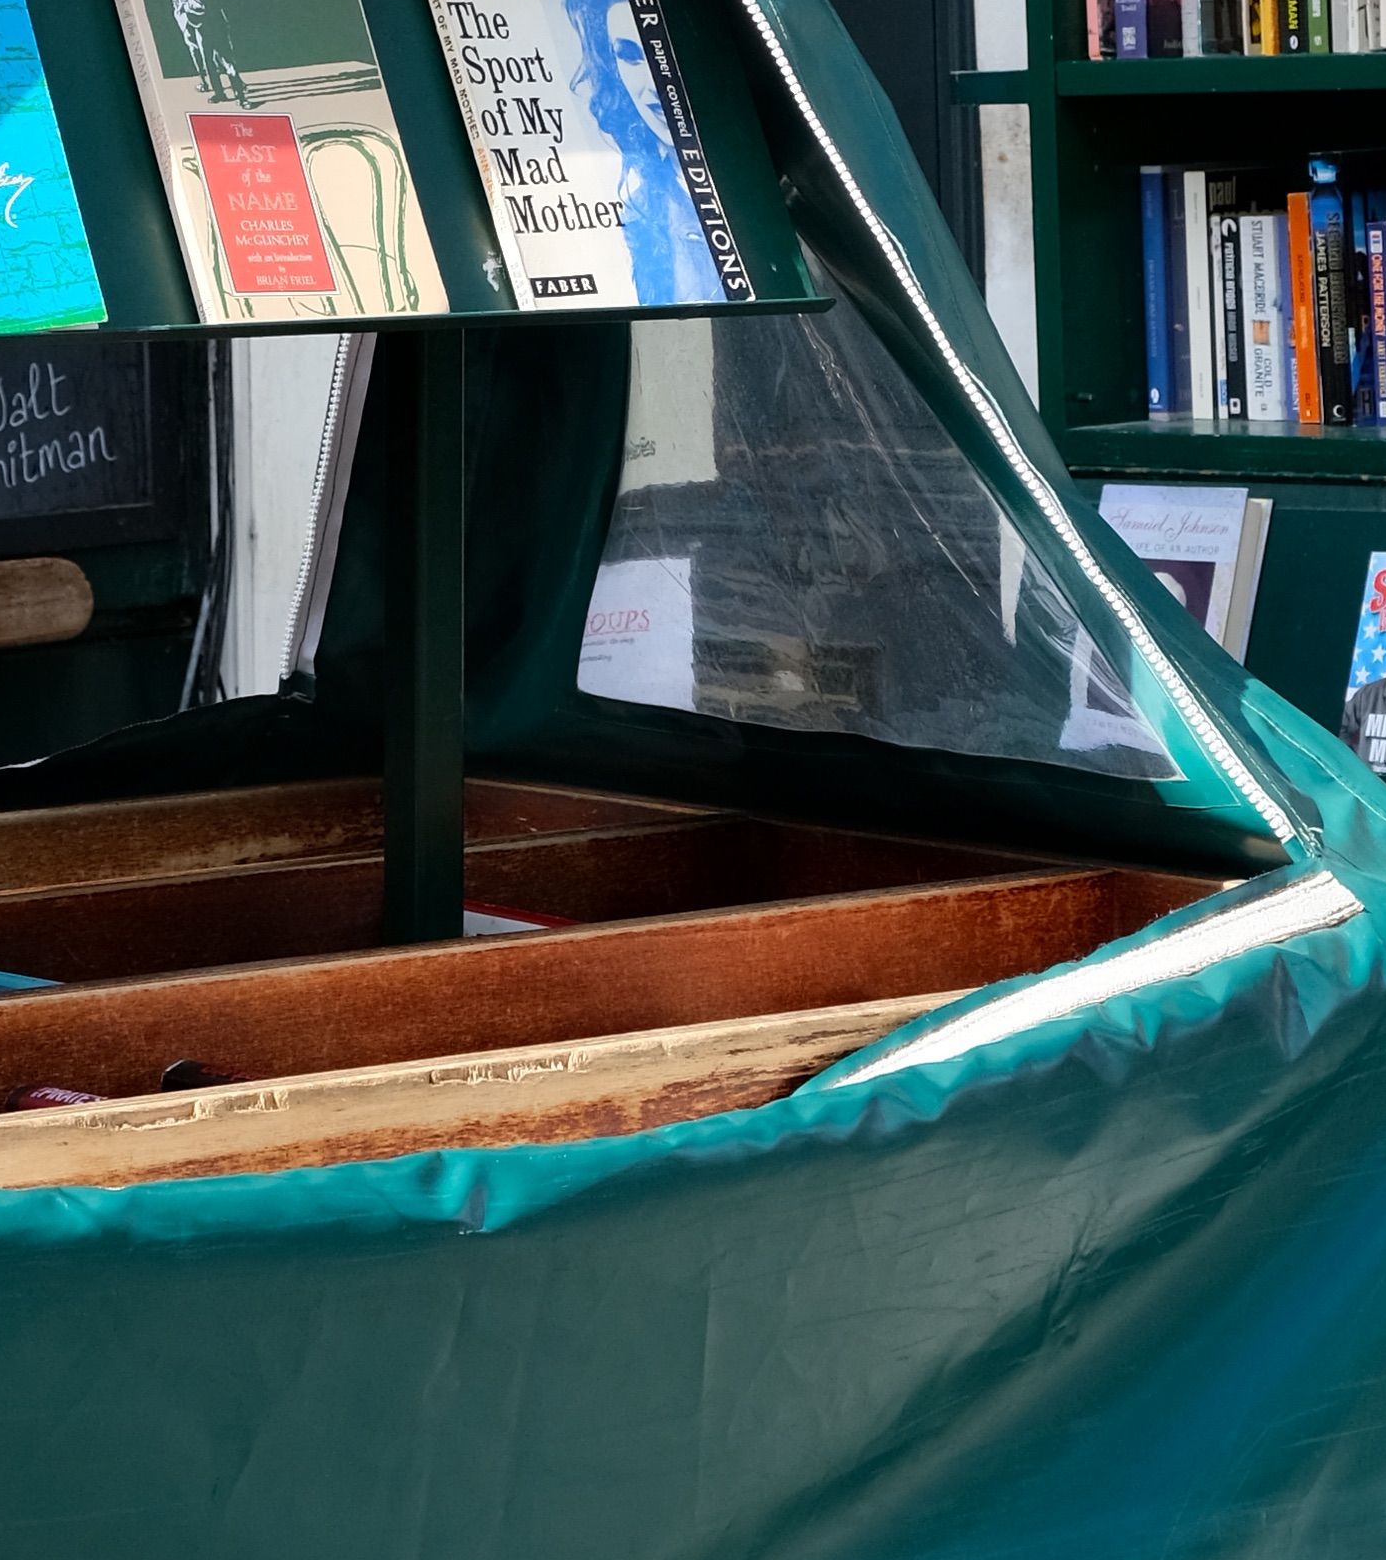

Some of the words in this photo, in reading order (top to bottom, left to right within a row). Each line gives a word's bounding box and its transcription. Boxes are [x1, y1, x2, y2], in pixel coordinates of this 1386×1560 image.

[446, 2, 510, 41] The
[462, 47, 553, 94] Sport
[481, 99, 513, 137] of
[511, 97, 564, 144] My
[220, 143, 277, 164] LAST
[490, 146, 569, 187] Mad
[648, 38, 673, 79] paper
[665, 84, 692, 138] covered
[681, 148, 747, 291] EDITIONS
[228, 192, 299, 212] NAME
[504, 193, 627, 235] Mother
[535, 277, 594, 297] FABER
